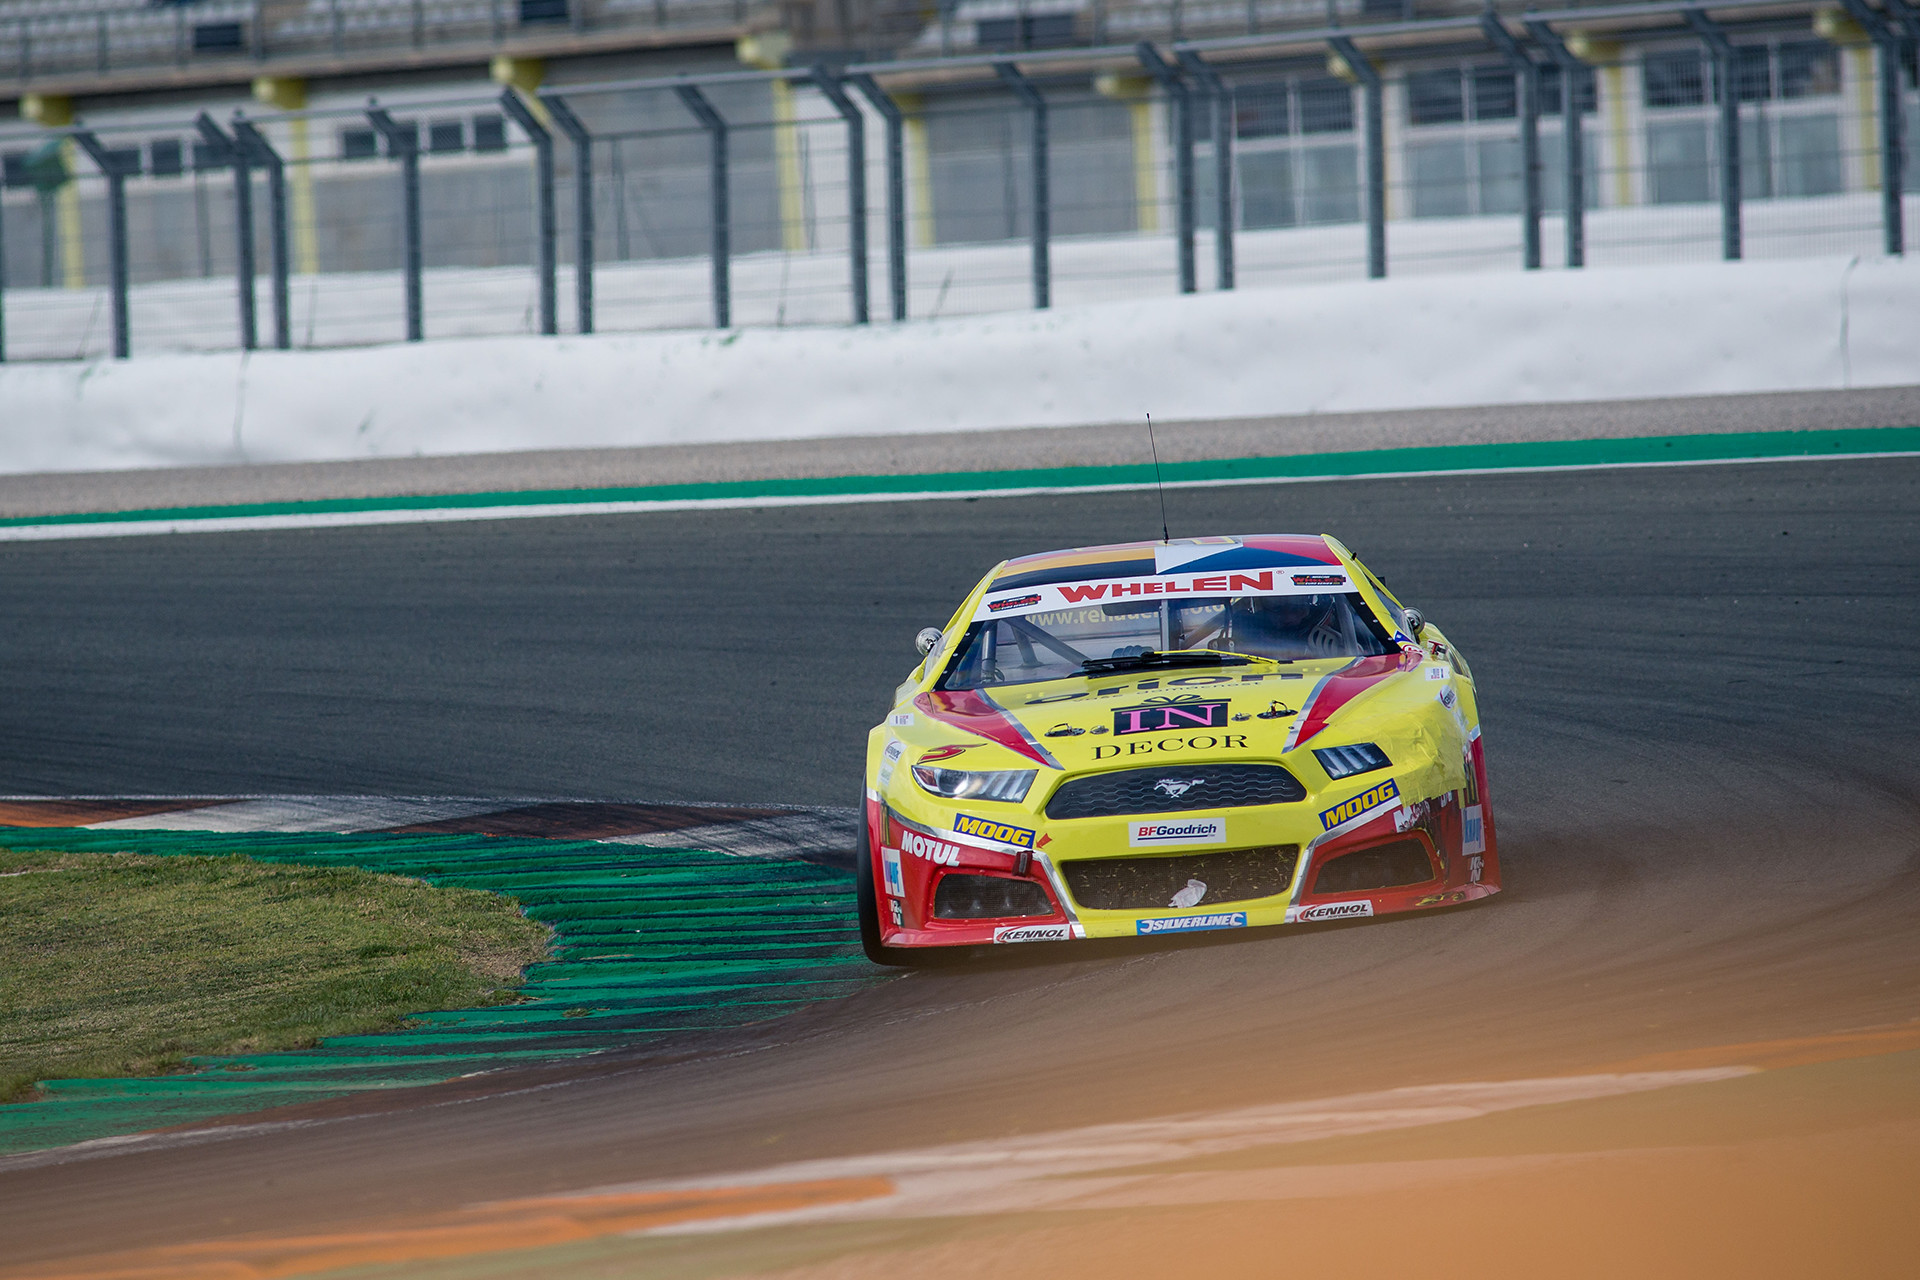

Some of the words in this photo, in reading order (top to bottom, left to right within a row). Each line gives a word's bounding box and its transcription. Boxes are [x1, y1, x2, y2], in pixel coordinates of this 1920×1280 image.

[1057, 571, 1274, 604] WHELEN
[1120, 704, 1221, 734] IN
[1091, 734, 1249, 761] DECOR
[1325, 781, 1394, 828] MOOG
[955, 816, 1032, 847] MOOG
[1138, 824, 1217, 837] BFGoodrich
[901, 830, 960, 867] MOTUL
[1304, 903, 1368, 918] KENNOL
[1001, 928, 1064, 939] KENNOL
